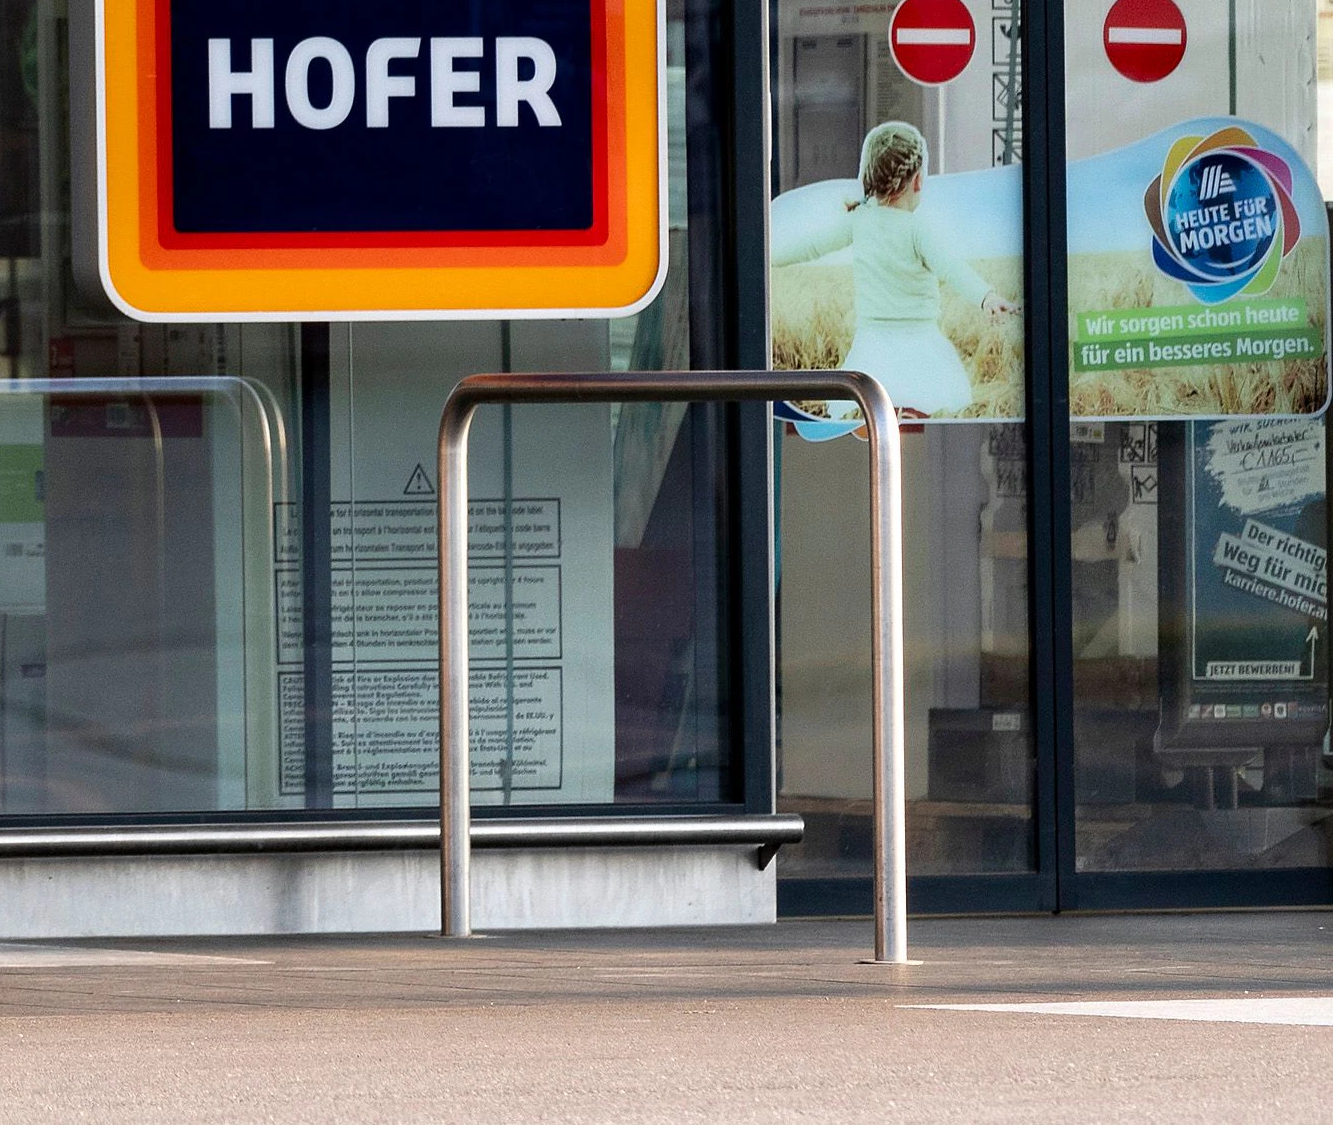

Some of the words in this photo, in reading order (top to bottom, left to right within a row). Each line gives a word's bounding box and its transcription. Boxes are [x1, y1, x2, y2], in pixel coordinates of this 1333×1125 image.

[207, 35, 564, 130] HOFER
[1175, 203, 1231, 231] HEUTE
[1233, 196, 1268, 222] FÜR
[1179, 216, 1274, 254] MORGEN
[1085, 314, 1116, 336] Wir
[1119, 312, 1183, 339] sorgen
[1187, 306, 1242, 329] schon
[1245, 303, 1300, 326] heute
[1080, 343, 1110, 368] für
[1114, 341, 1145, 364] ein
[1149, 337, 1232, 361] besseres
[1236, 336, 1315, 362] Morgen.
[1247, 525, 1275, 547] Der
[1276, 537, 1327, 572] richtig
[1223, 542, 1261, 573] Weg
[1264, 556, 1292, 581] für
[1294, 570, 1327, 596] mic
[1209, 664, 1236, 676] JETZT
[1238, 664, 1295, 676] BEWERBEN!
